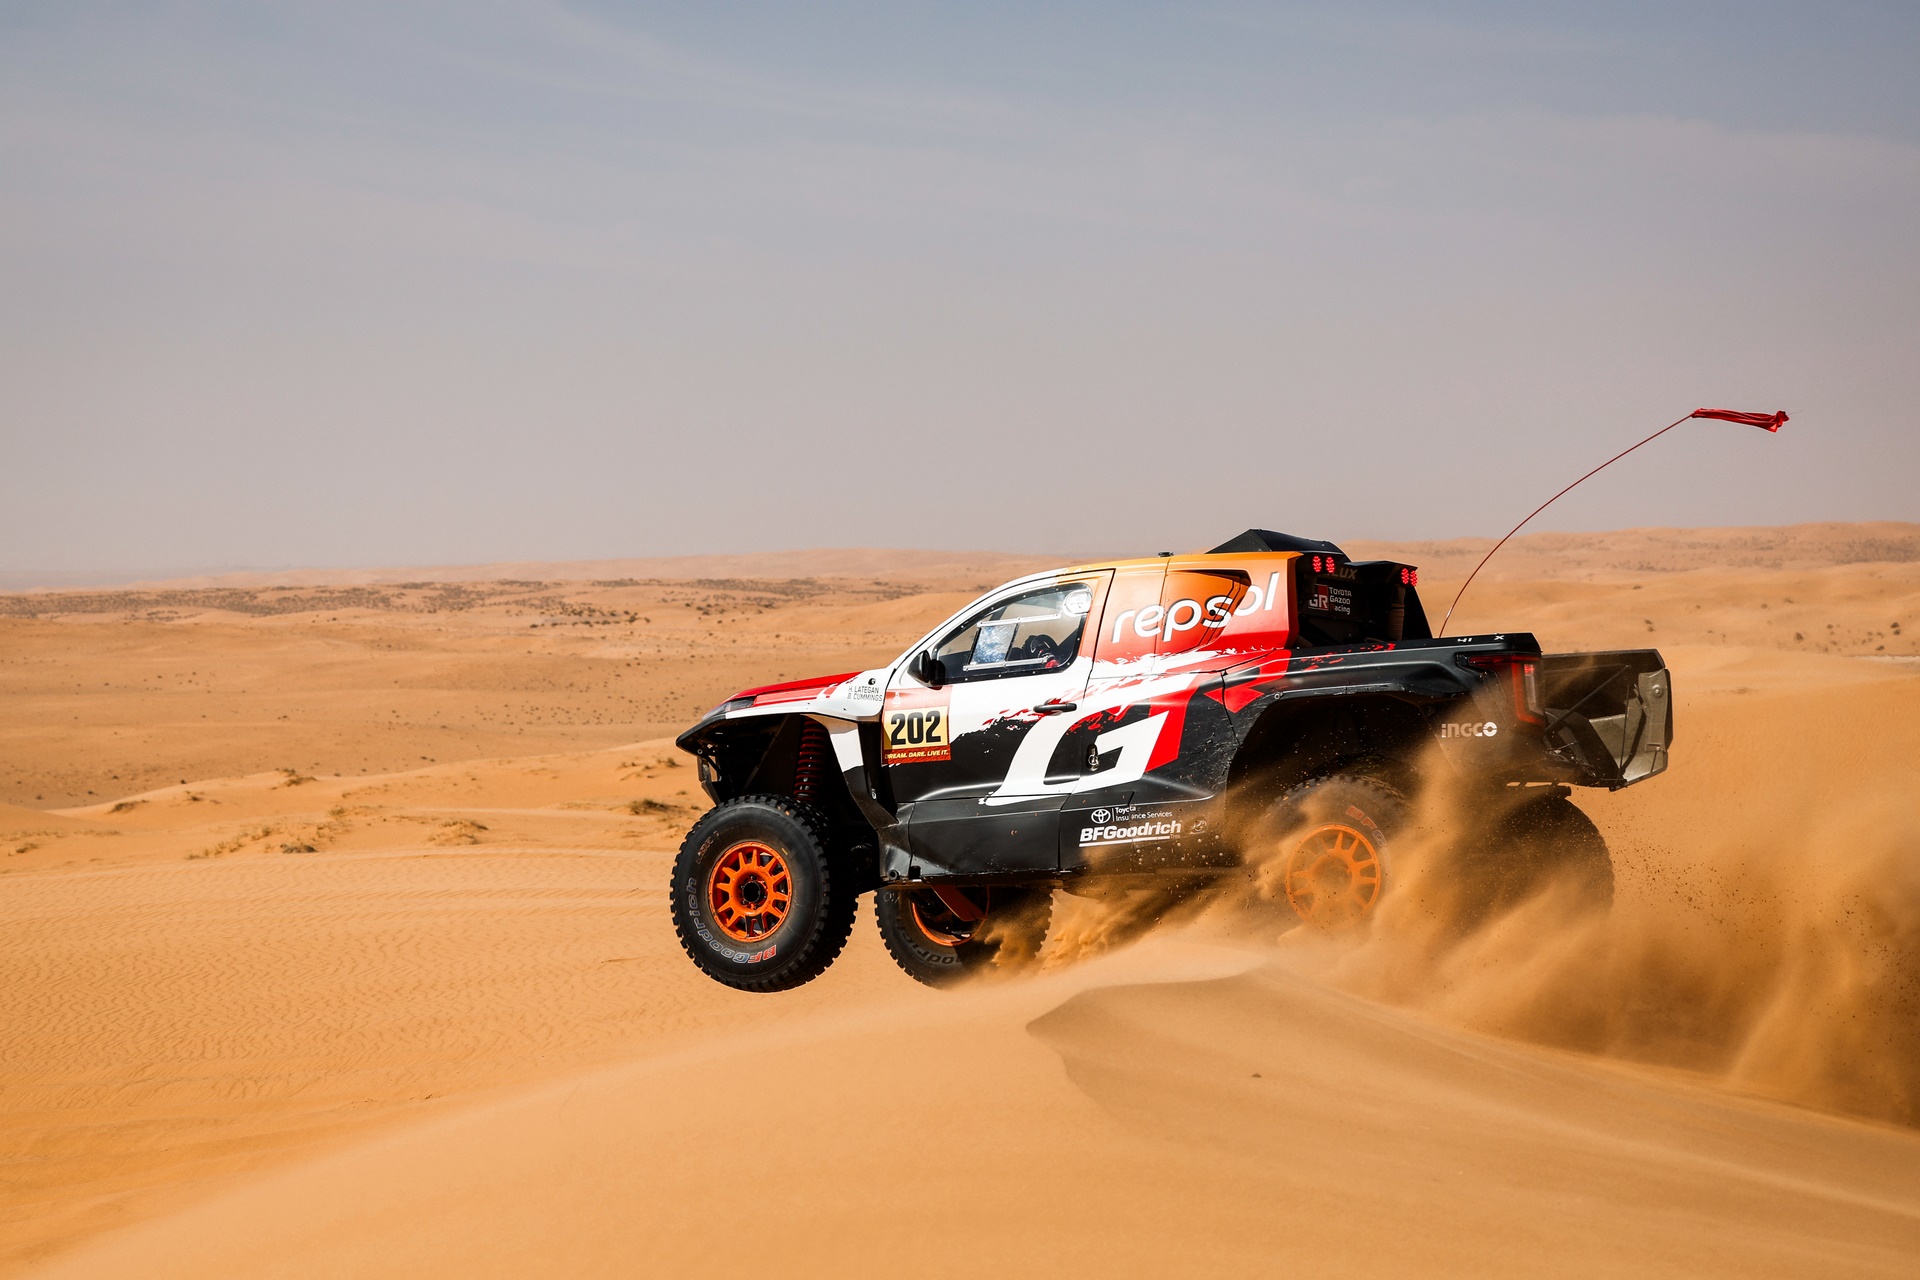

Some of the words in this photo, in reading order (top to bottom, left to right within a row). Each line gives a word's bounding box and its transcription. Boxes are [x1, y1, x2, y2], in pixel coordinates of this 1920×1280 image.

[1328, 586, 1352, 597] TOYOTA
[1308, 594, 1329, 609] GR
[1329, 595, 1351, 605] GAZOO
[1111, 571, 1280, 644] repsol
[854, 686, 880, 694] LATEGAN
[853, 693, 883, 702] CUMMINGS
[890, 710, 942, 746] 202
[1115, 812, 1146, 822] Insuance
[1147, 810, 1173, 819] Services
[1080, 820, 1182, 842] BFGoodrich
